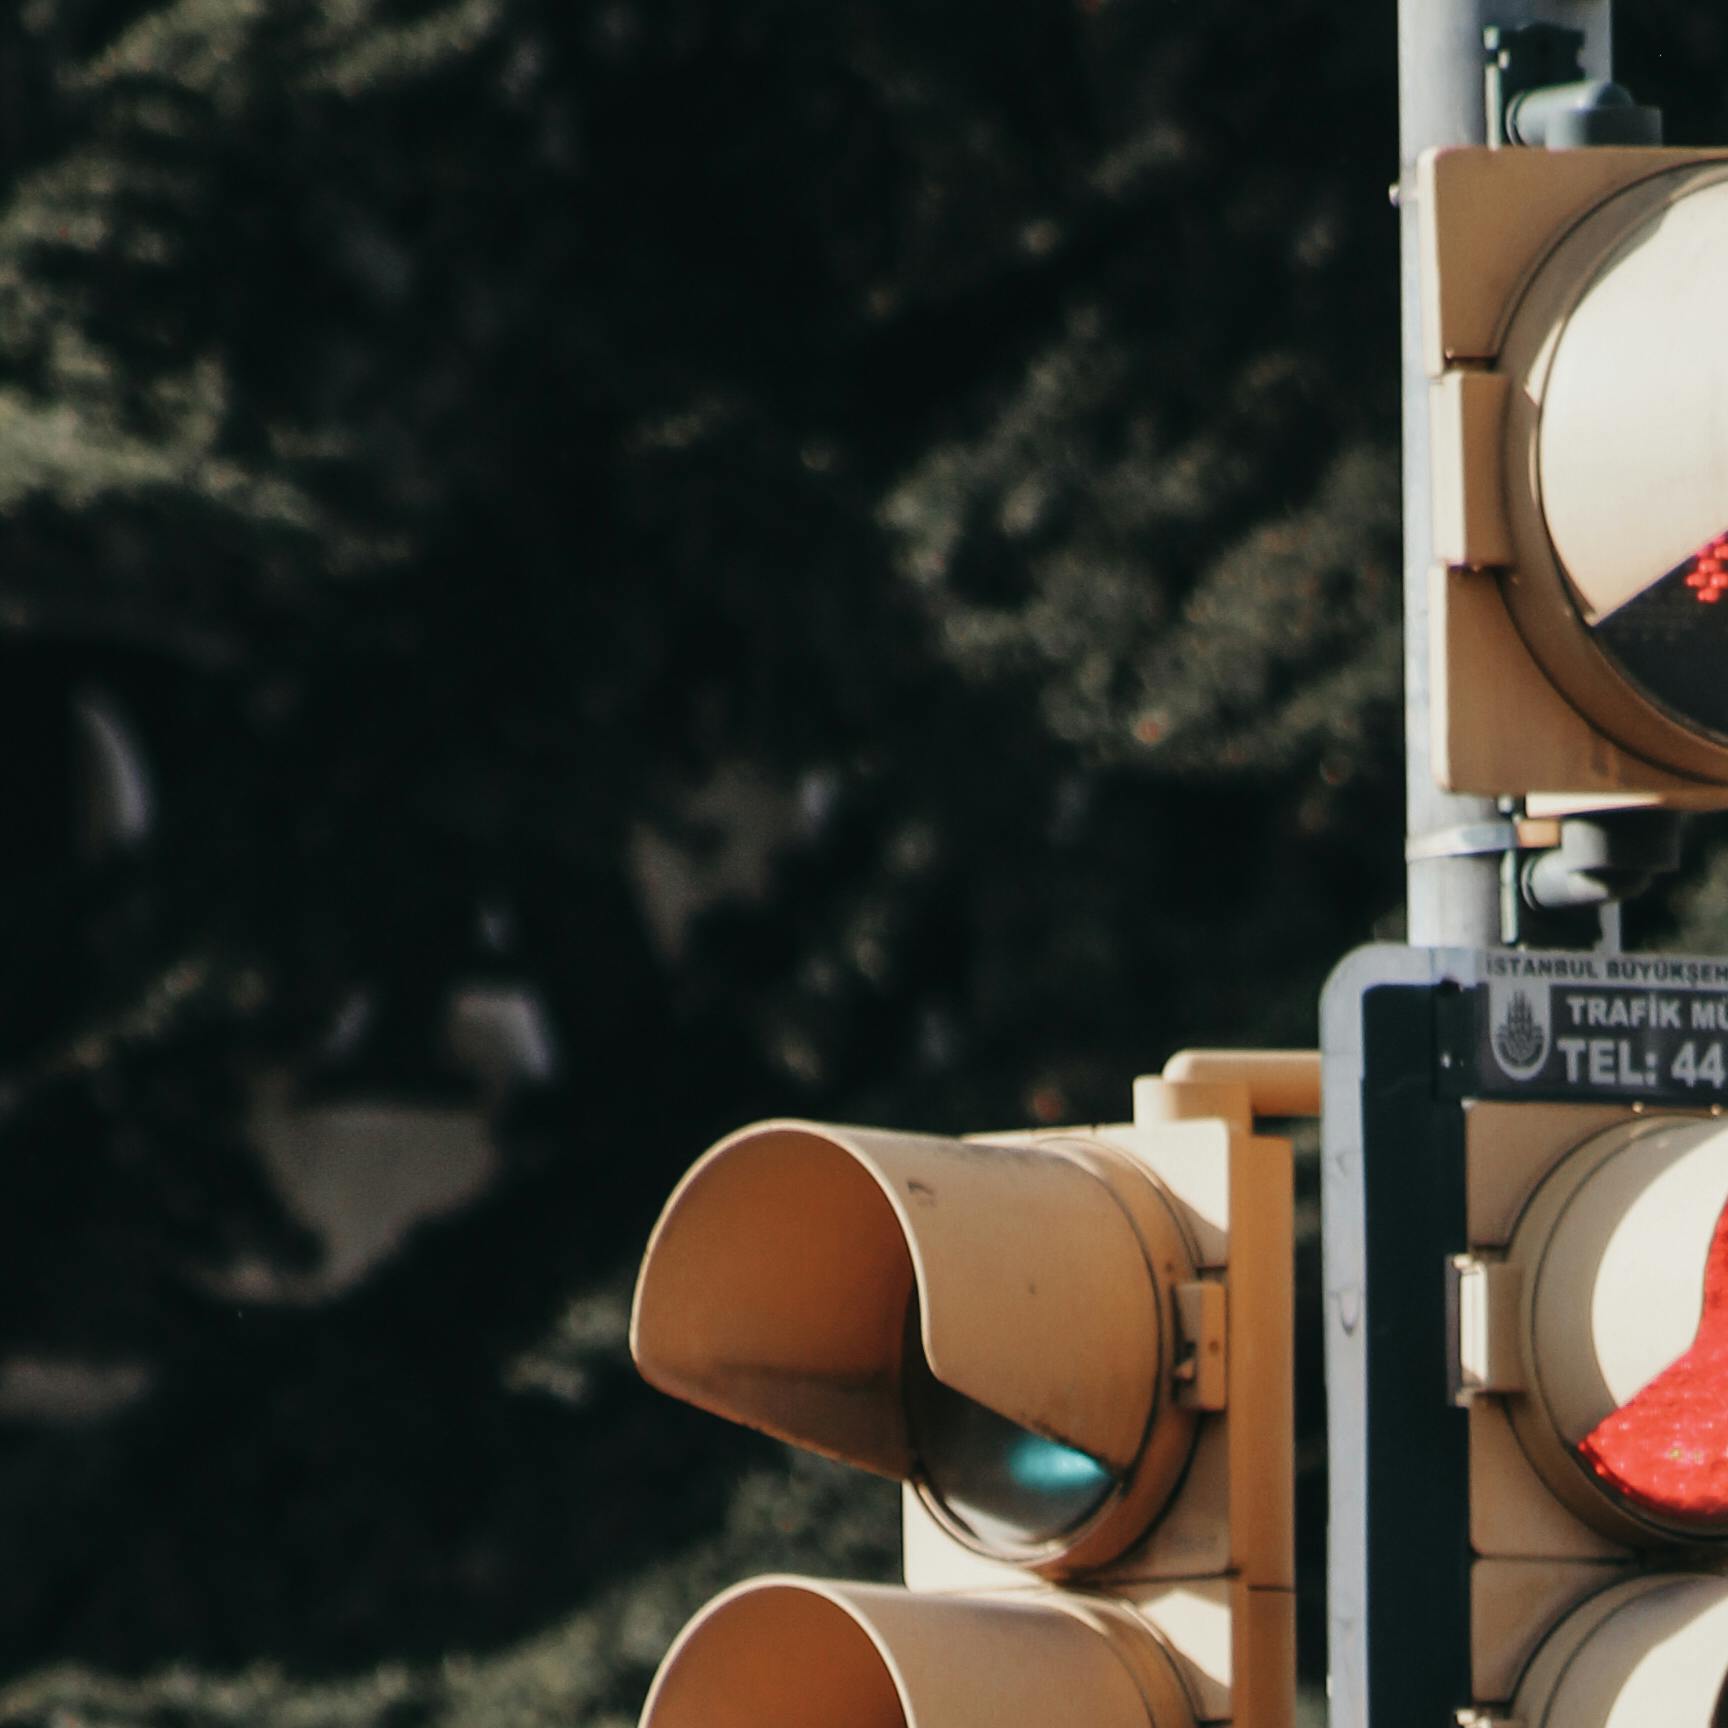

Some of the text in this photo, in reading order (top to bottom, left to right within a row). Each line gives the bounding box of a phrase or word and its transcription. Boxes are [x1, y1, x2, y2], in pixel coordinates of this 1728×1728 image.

[1566, 991, 1681, 1028] TRAFİK
[1556, 1038, 1658, 1085] TEL:
[1671, 1041, 1726, 1088] 44
